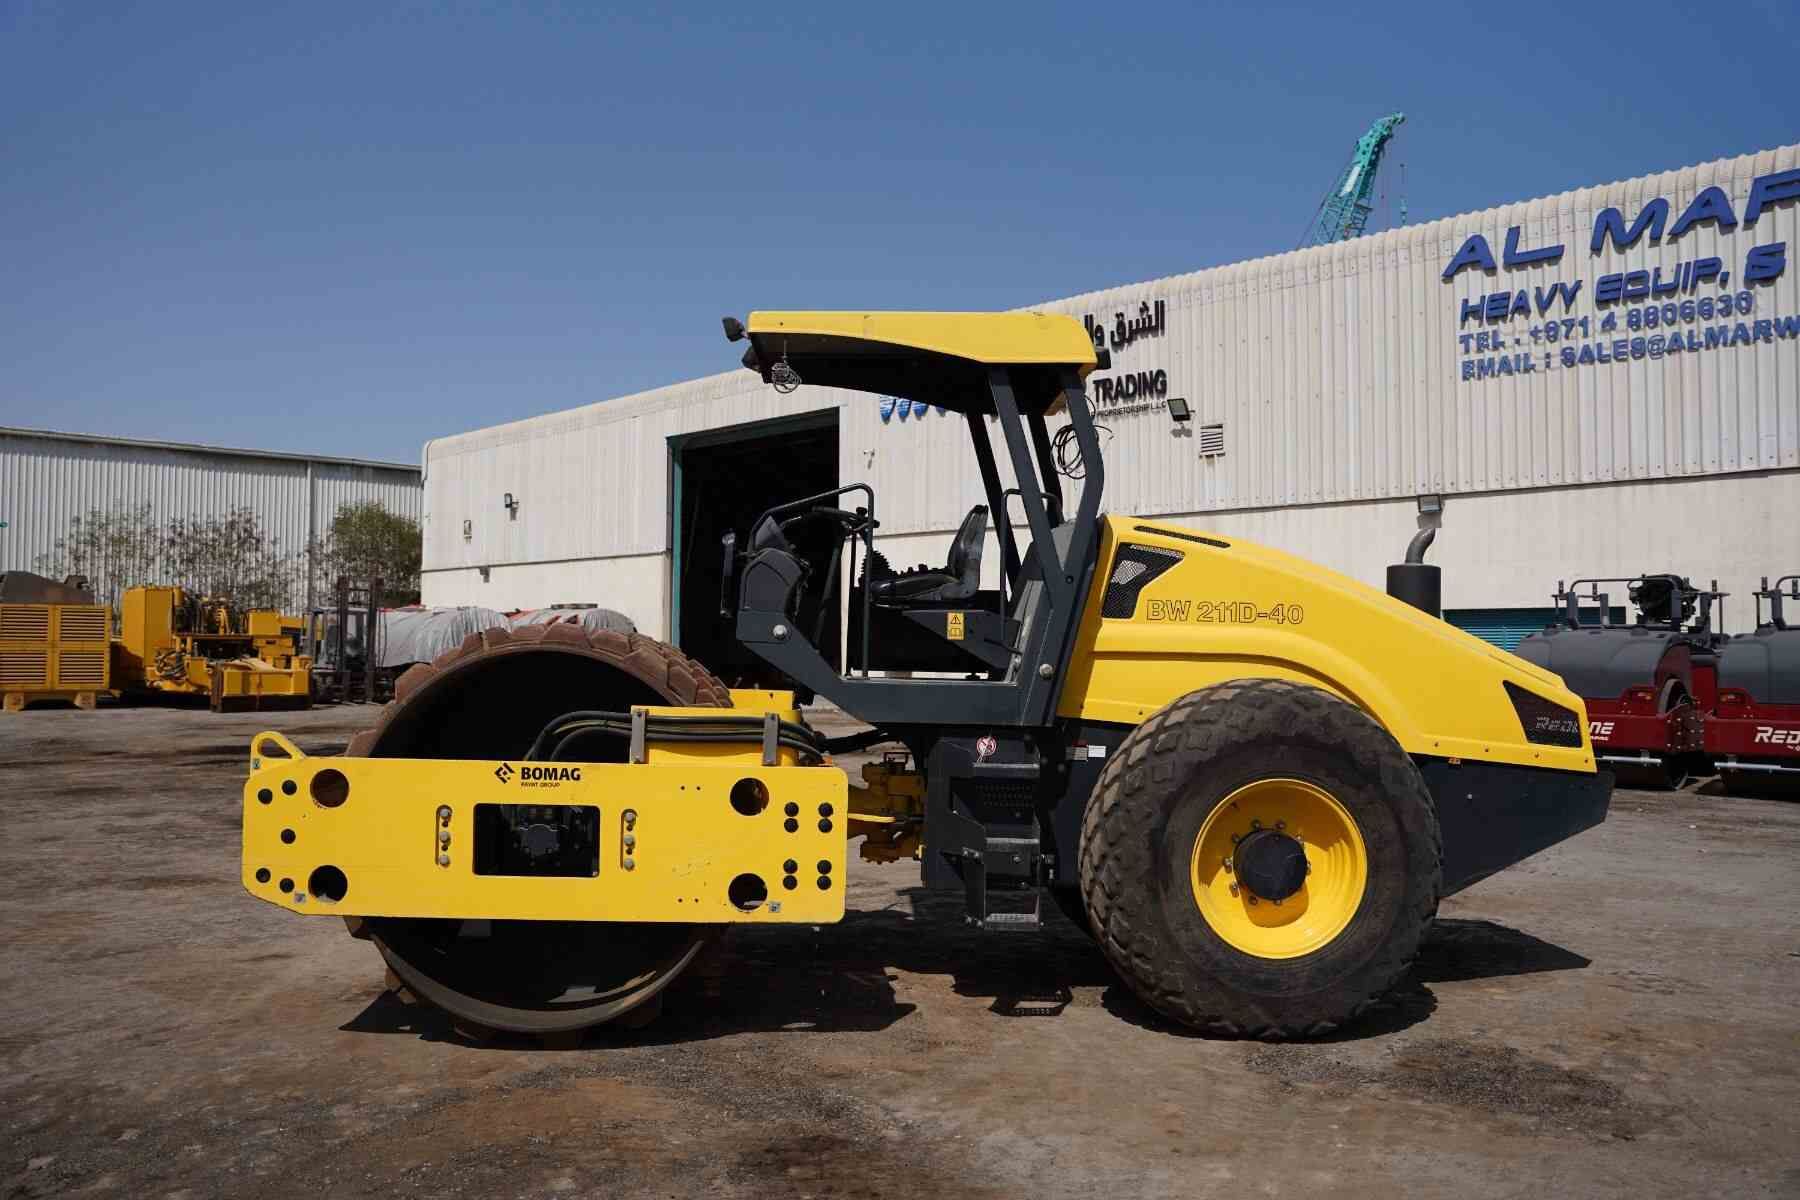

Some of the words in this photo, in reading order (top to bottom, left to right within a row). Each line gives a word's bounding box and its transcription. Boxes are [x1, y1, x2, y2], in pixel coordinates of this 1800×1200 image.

[1441, 226, 1565, 280] AL
[1460, 279, 1583, 328] HEAVY
[1109, 300, 1165, 346] الشرق
[1601, 311, 1617, 331] 4
[1461, 352, 1536, 382] EMAIL
[1093, 369, 1167, 405] TRADING
[1146, 600, 1191, 621] BW
[1197, 602, 1304, 624] 211D-40
[521, 767, 581, 781] BOMAG
